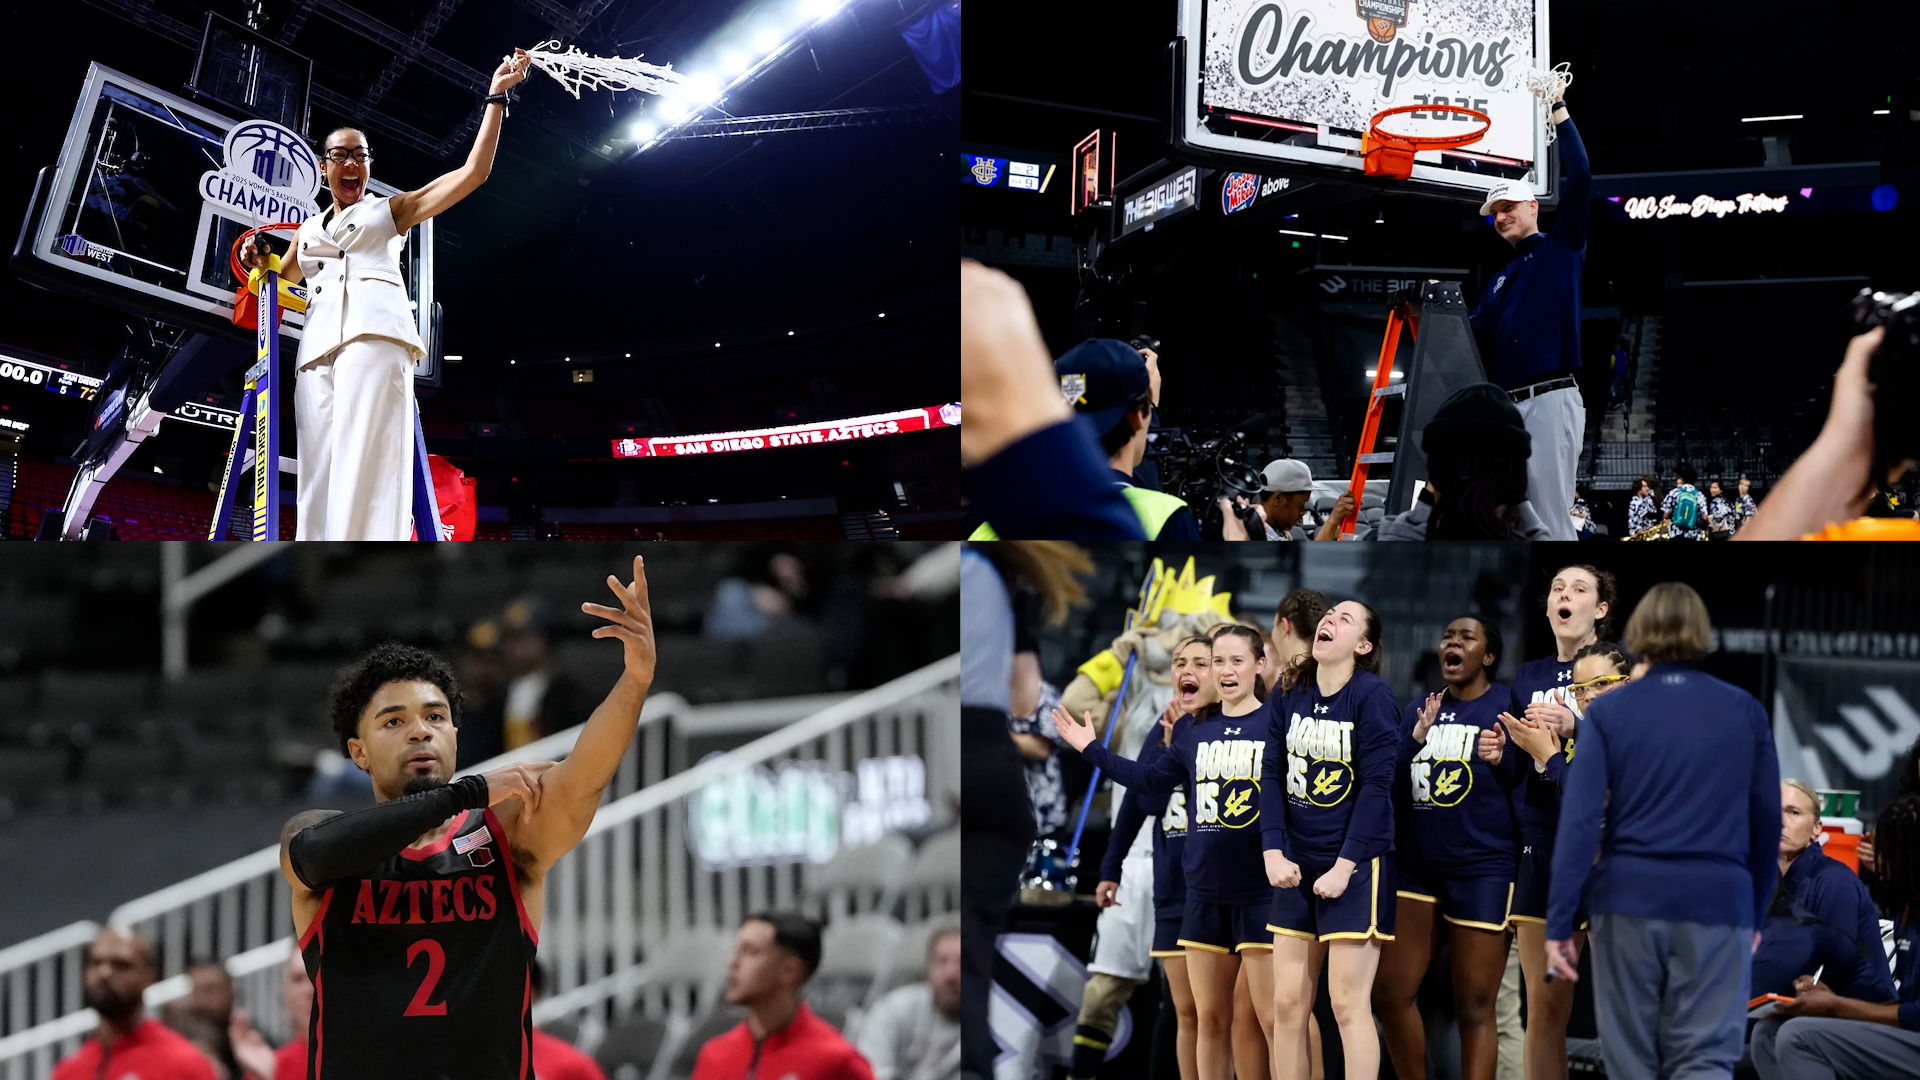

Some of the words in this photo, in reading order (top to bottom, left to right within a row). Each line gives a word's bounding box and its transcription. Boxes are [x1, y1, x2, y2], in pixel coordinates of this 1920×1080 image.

[1238, 3, 1514, 98] Champions
[1410, 94, 1489, 123] 2025
[232, 174, 248, 186] 2025
[248, 182, 275, 197] WOMEN'S
[275, 191, 309, 210] BASKETBALL
[1261, 177, 1290, 197] above
[1624, 196, 1658, 219] UC
[87, 248, 113, 263] WEST
[1351, 278, 1384, 293] THE
[0, 362, 43, 385] 00.0
[80, 386, 98, 401] 72
[674, 441, 708, 455] SAN
[710, 437, 765, 452] DIEGO
[769, 430, 825, 448] STATE
[827, 421, 900, 442] AZTECS
[256, 415, 267, 502] BASKETBALL
[1286, 712, 1355, 763] DOUBT
[1412, 723, 1480, 763] OUBT
[1195, 739, 1266, 782] DOUBT
[1286, 752, 1308, 800] US
[1410, 762, 1432, 802] US
[1195, 782, 1220, 825] US
[350, 874, 498, 925] AZTECS
[402, 938, 448, 1017] 2
